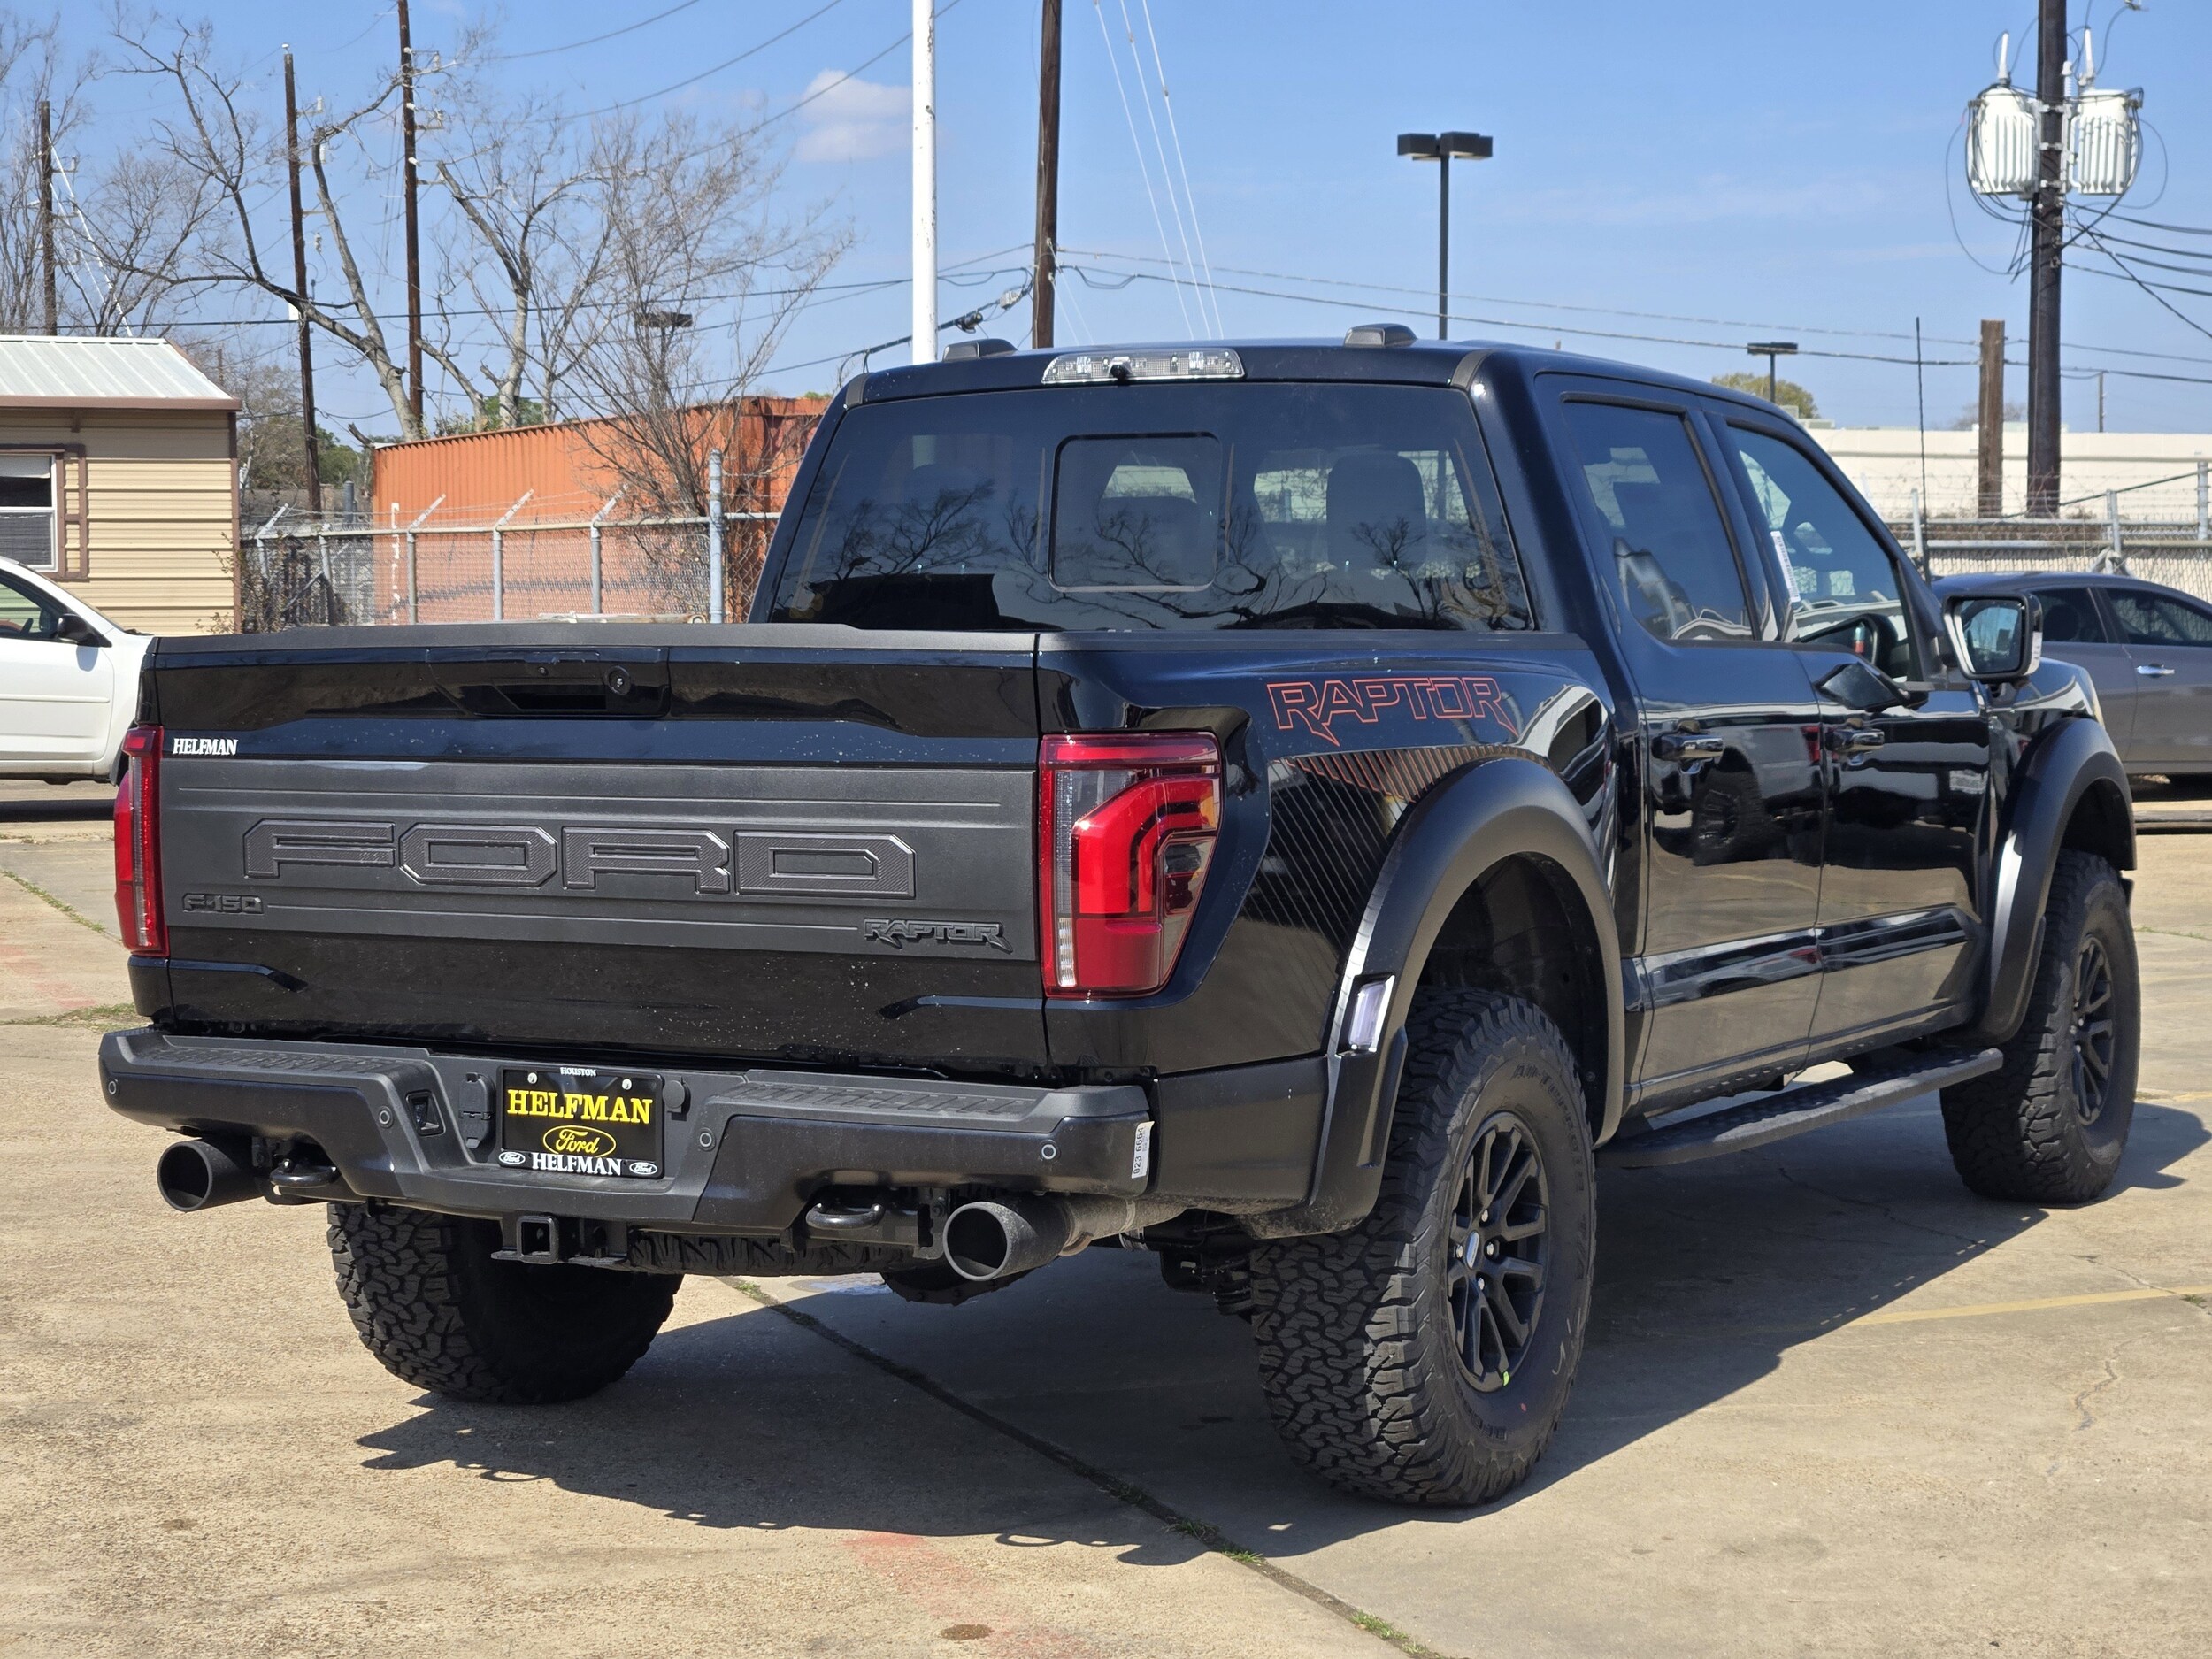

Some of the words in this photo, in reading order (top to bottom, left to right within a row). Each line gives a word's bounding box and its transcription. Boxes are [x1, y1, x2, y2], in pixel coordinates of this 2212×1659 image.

[1267, 677, 1519, 747] RAPTOR
[173, 738, 239, 756] HELFMAN
[242, 819, 917, 899] FORD
[182, 893, 264, 915] F-150
[864, 918, 1013, 955] RAPTOR
[560, 1067, 596, 1077] HOUSTON
[507, 1089, 653, 1125] HELFMAN
[556, 1128, 600, 1153] Ford
[532, 1152, 622, 1176] HELFMAN
[1133, 1156, 1142, 1174] 023
